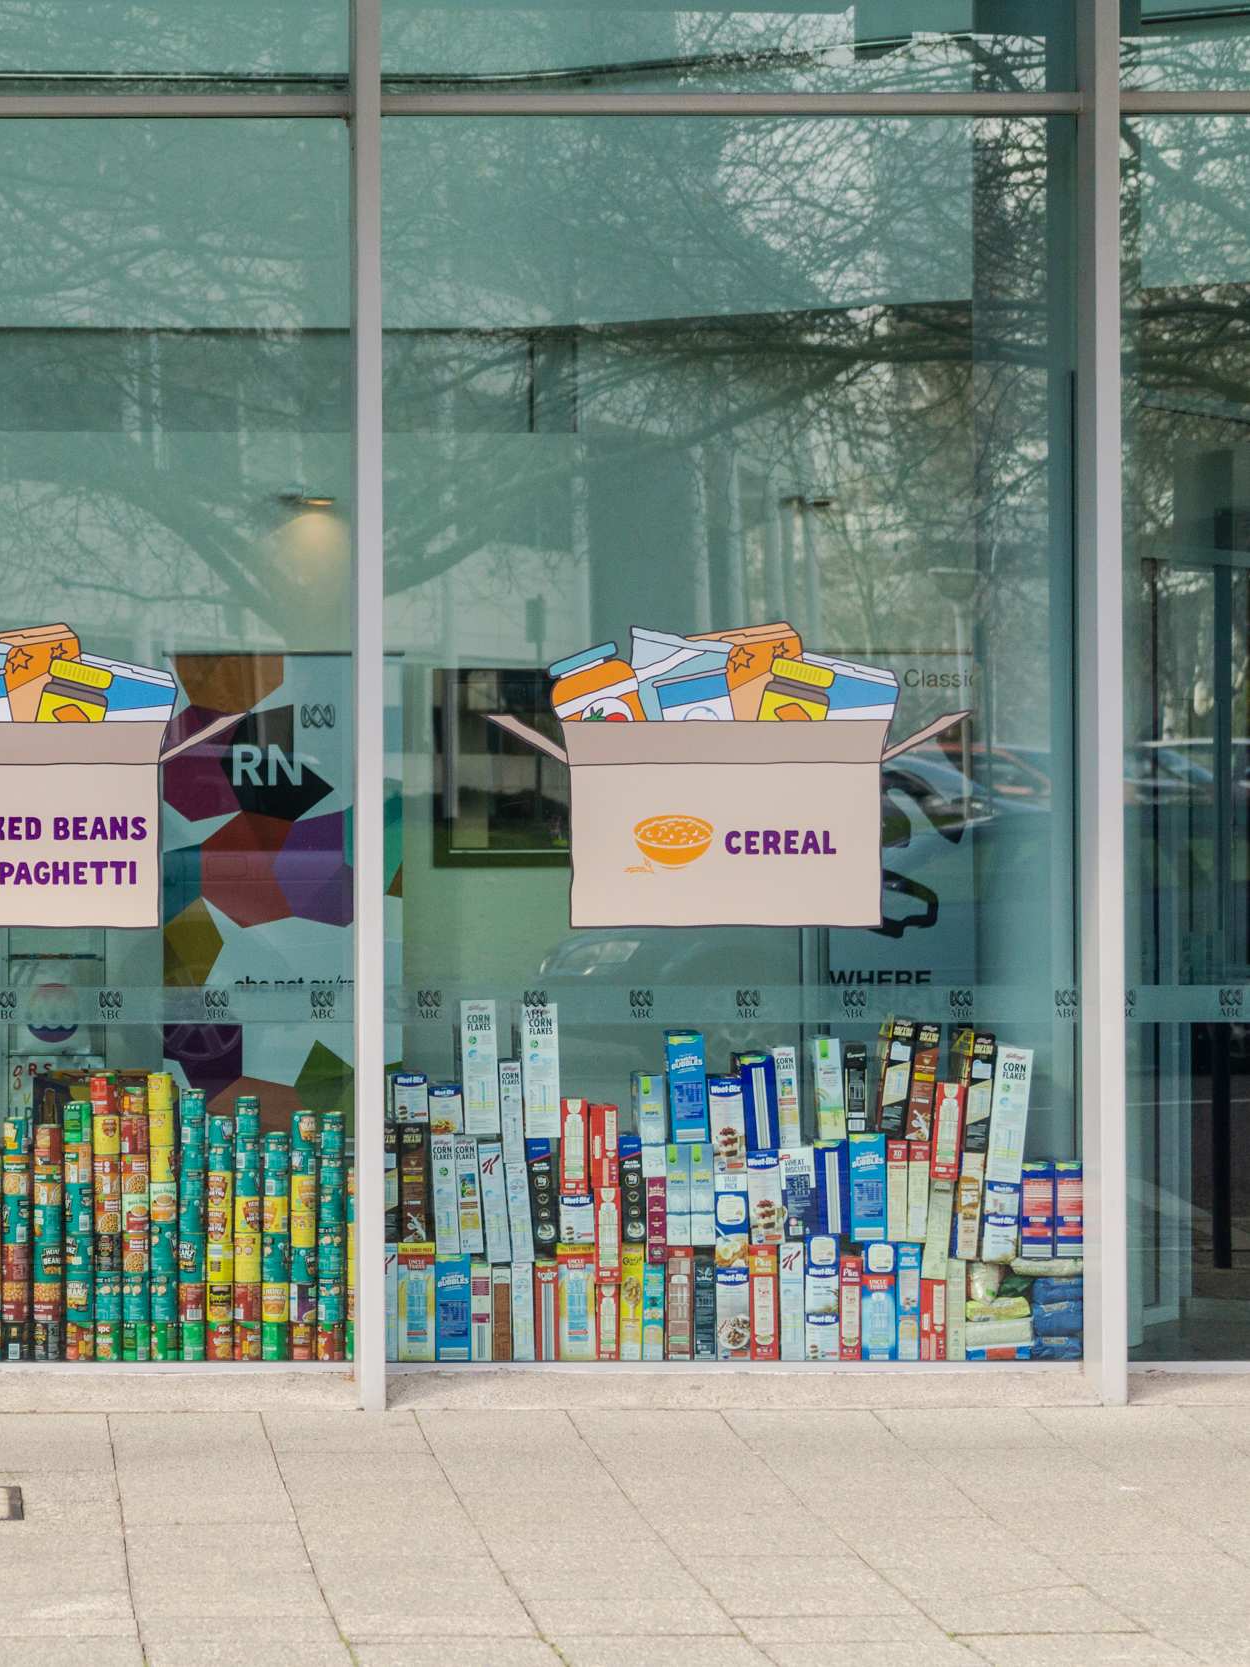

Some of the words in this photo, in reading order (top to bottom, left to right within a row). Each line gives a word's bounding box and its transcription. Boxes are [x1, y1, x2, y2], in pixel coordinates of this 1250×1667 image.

[232, 743, 303, 787] RN
[52, 816, 148, 841] BEANS
[724, 830, 838, 855] CEREAL
[99, 1010, 123, 1020] ABC
[311, 1009, 335, 1019] ABC
[418, 1009, 442, 1019] ABC
[630, 1009, 653, 1019] ABC
[736, 1009, 760, 1019] ABC
[1055, 1008, 1078, 1018] ABC
[466, 1014, 490, 1023] CORN
[528, 1019, 552, 1027] CORN
[467, 1023, 491, 1032] FLAKES
[529, 1027, 553, 1035] FLAKES
[1003, 1062, 1027, 1073] CORN
[501, 1072, 519, 1080] CORN
[1002, 1071, 1026, 1081] FLAKES
[433, 1146, 452, 1154] CORN
